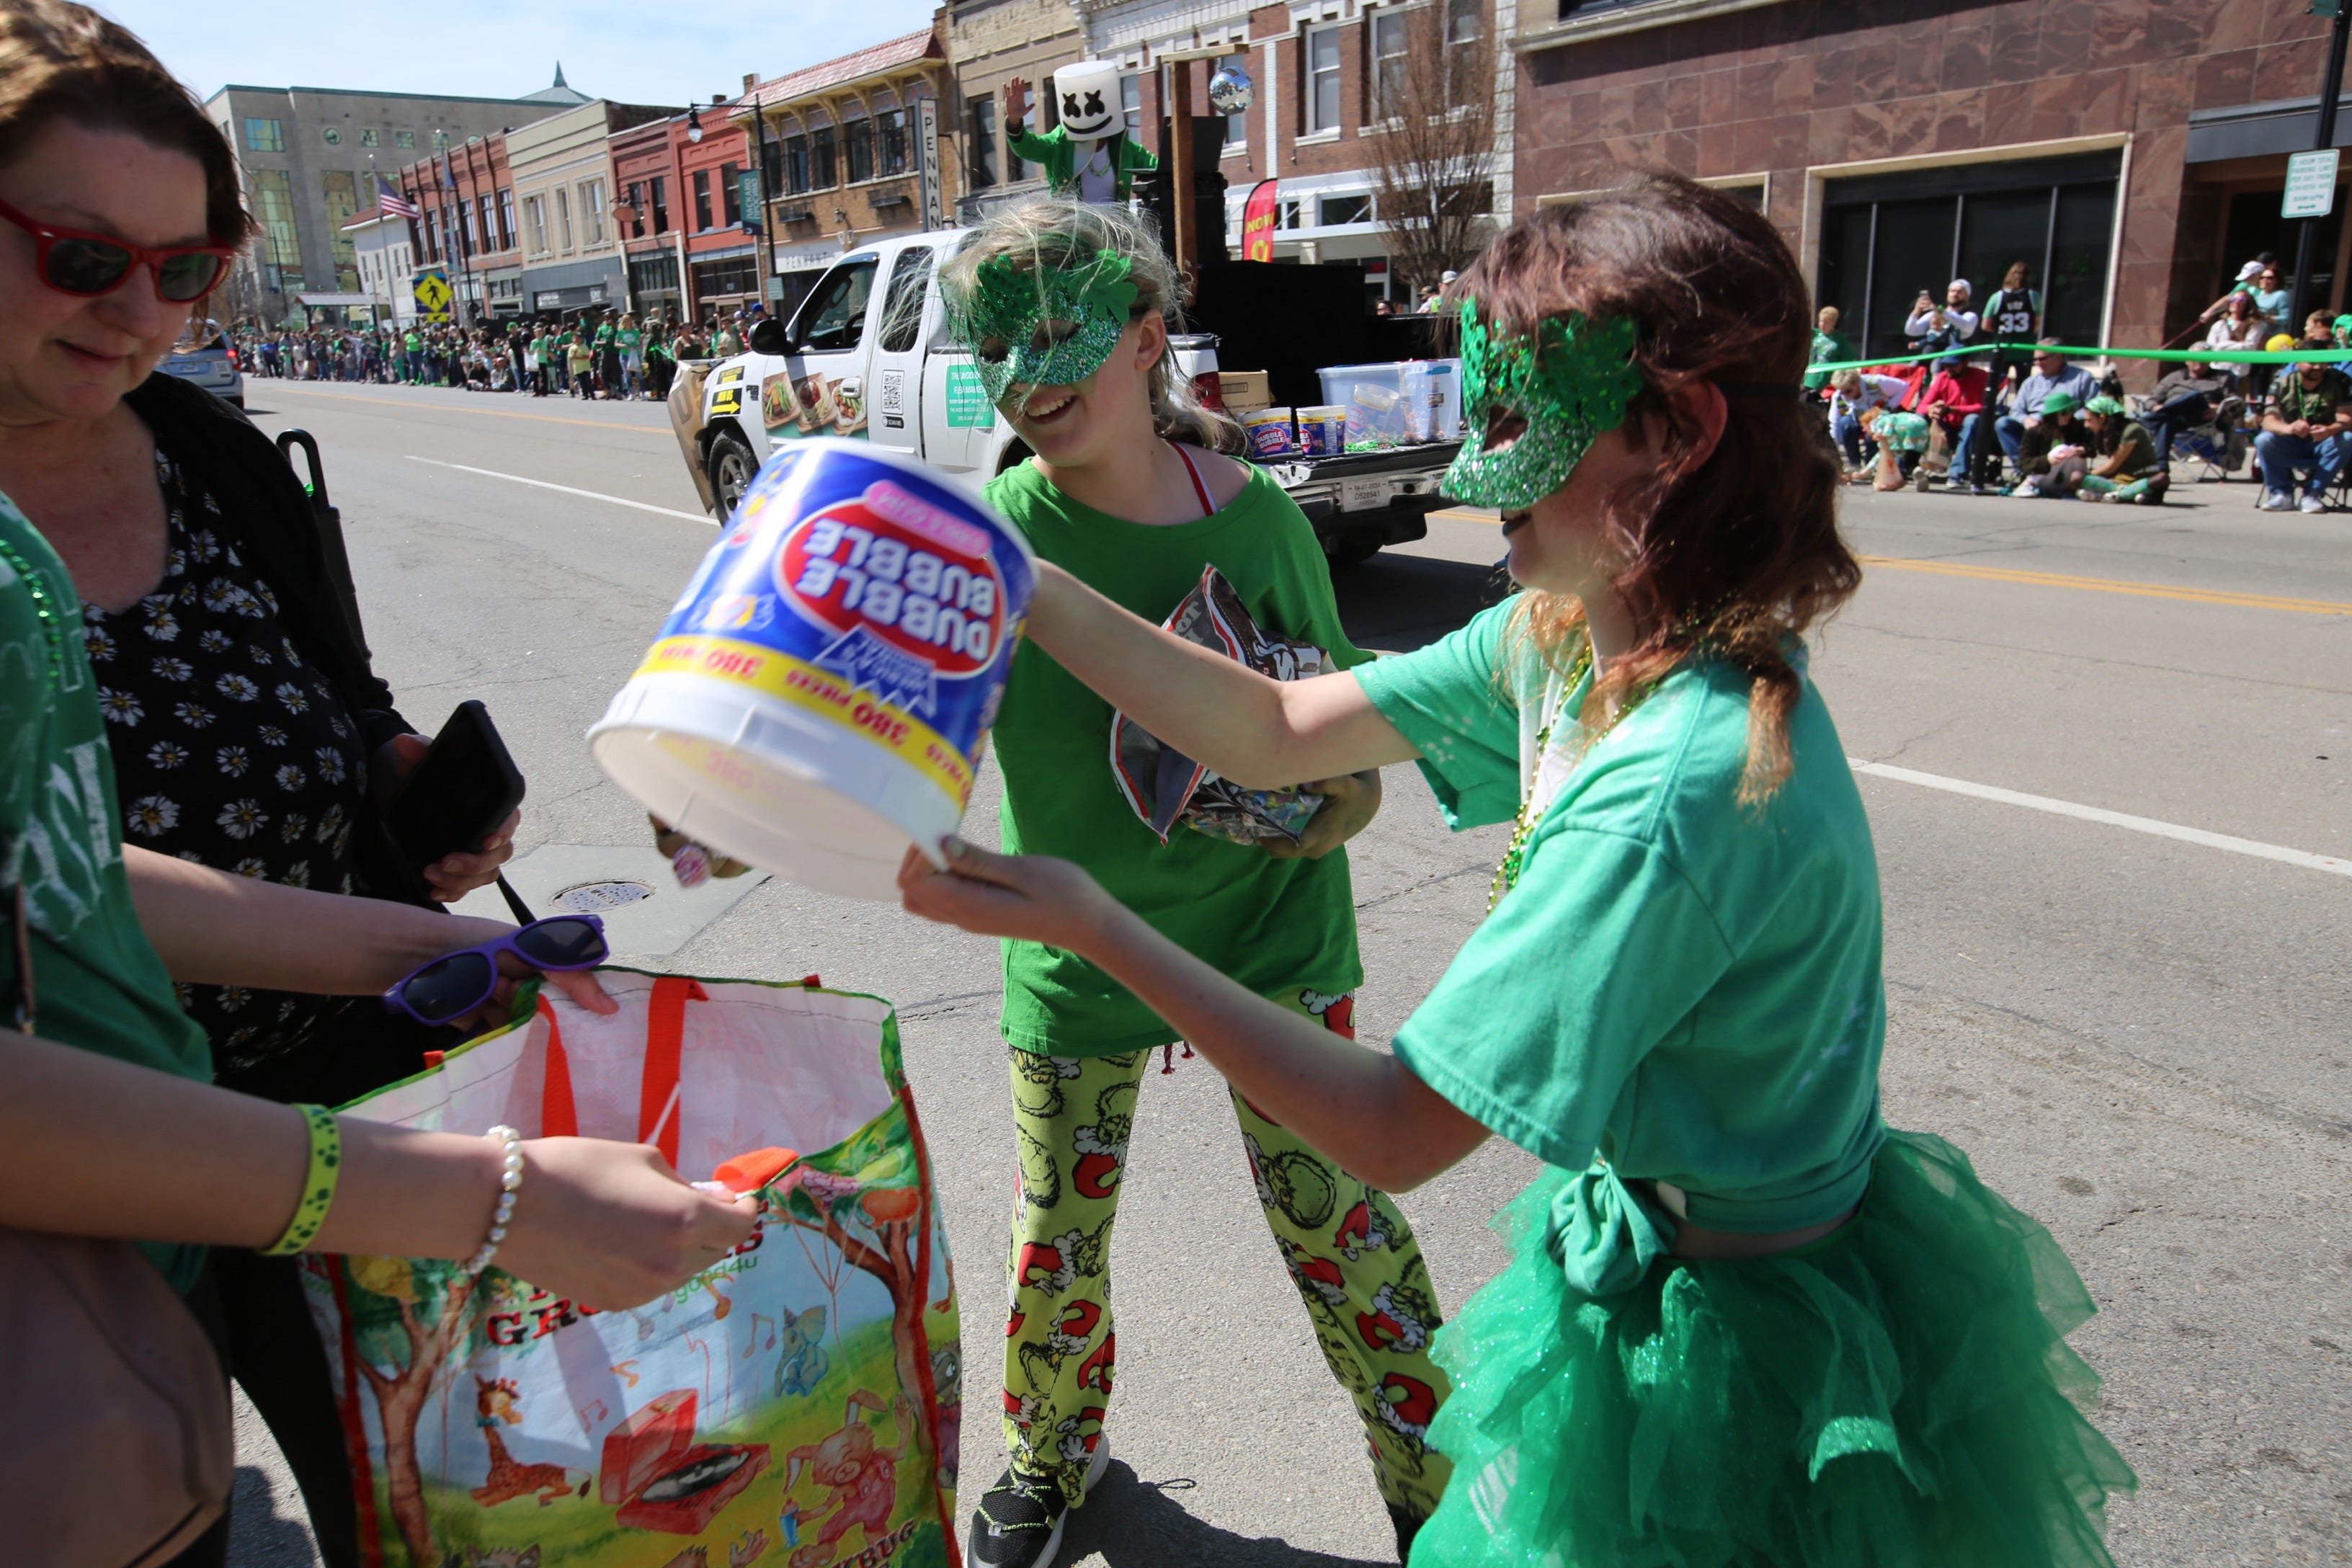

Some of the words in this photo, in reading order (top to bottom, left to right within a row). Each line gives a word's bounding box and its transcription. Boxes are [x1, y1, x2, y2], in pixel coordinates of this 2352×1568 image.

[925, 116, 940, 228] PENNAN
[1998, 311, 2030, 334] 33
[794, 556, 990, 662] DUBBLE
[801, 517, 996, 618] BUBBLE
[704, 650, 766, 680] 380
